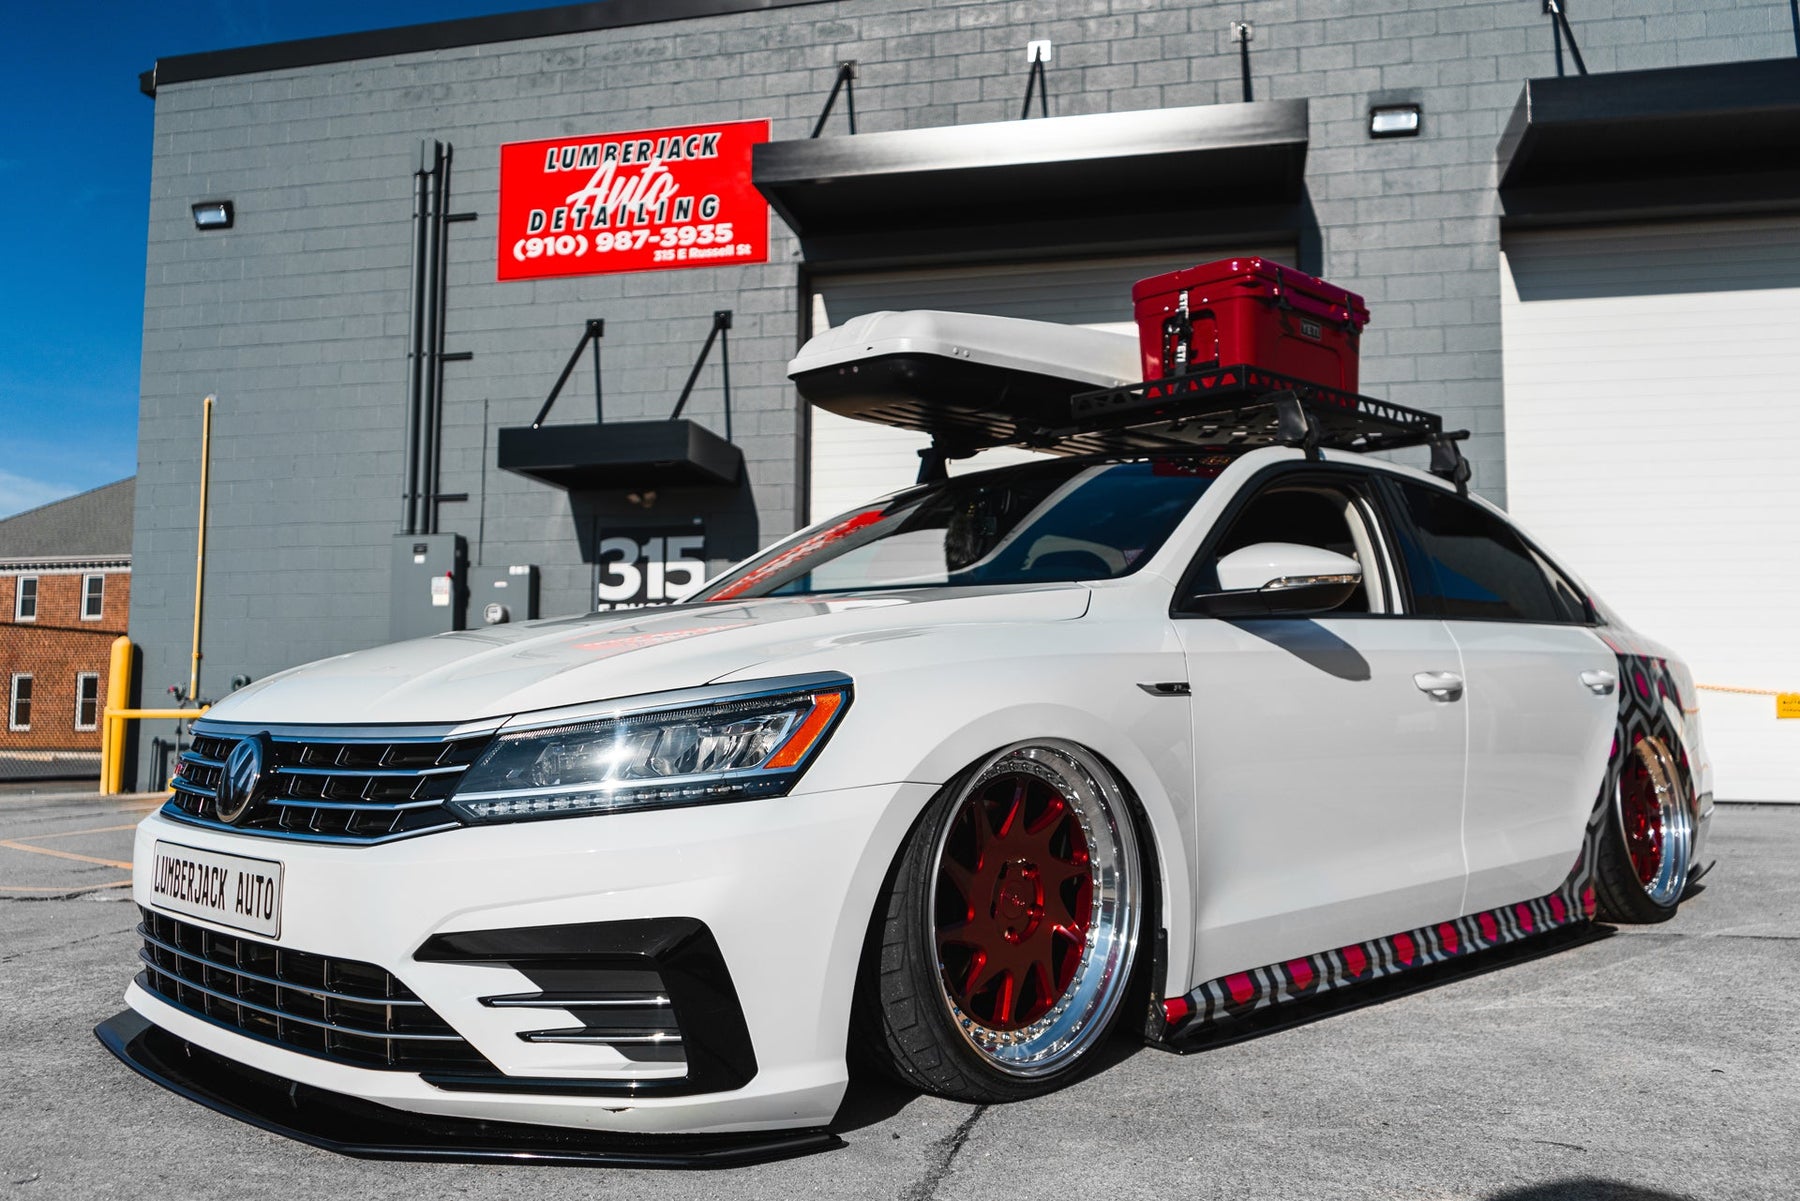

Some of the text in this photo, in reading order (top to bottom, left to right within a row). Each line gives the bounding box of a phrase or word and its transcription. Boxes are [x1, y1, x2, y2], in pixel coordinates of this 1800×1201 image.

[544, 132, 722, 173] LUMBERJACK
[565, 157, 680, 218] Auto
[527, 194, 720, 235] DETAILING
[513, 223, 733, 261] (910) 987-3935
[653, 243, 752, 262] 315 E Russell St
[1302, 323, 1319, 337] YETI
[598, 536, 705, 601] 315
[154, 854, 275, 921] LUMBERJACK AUTO
